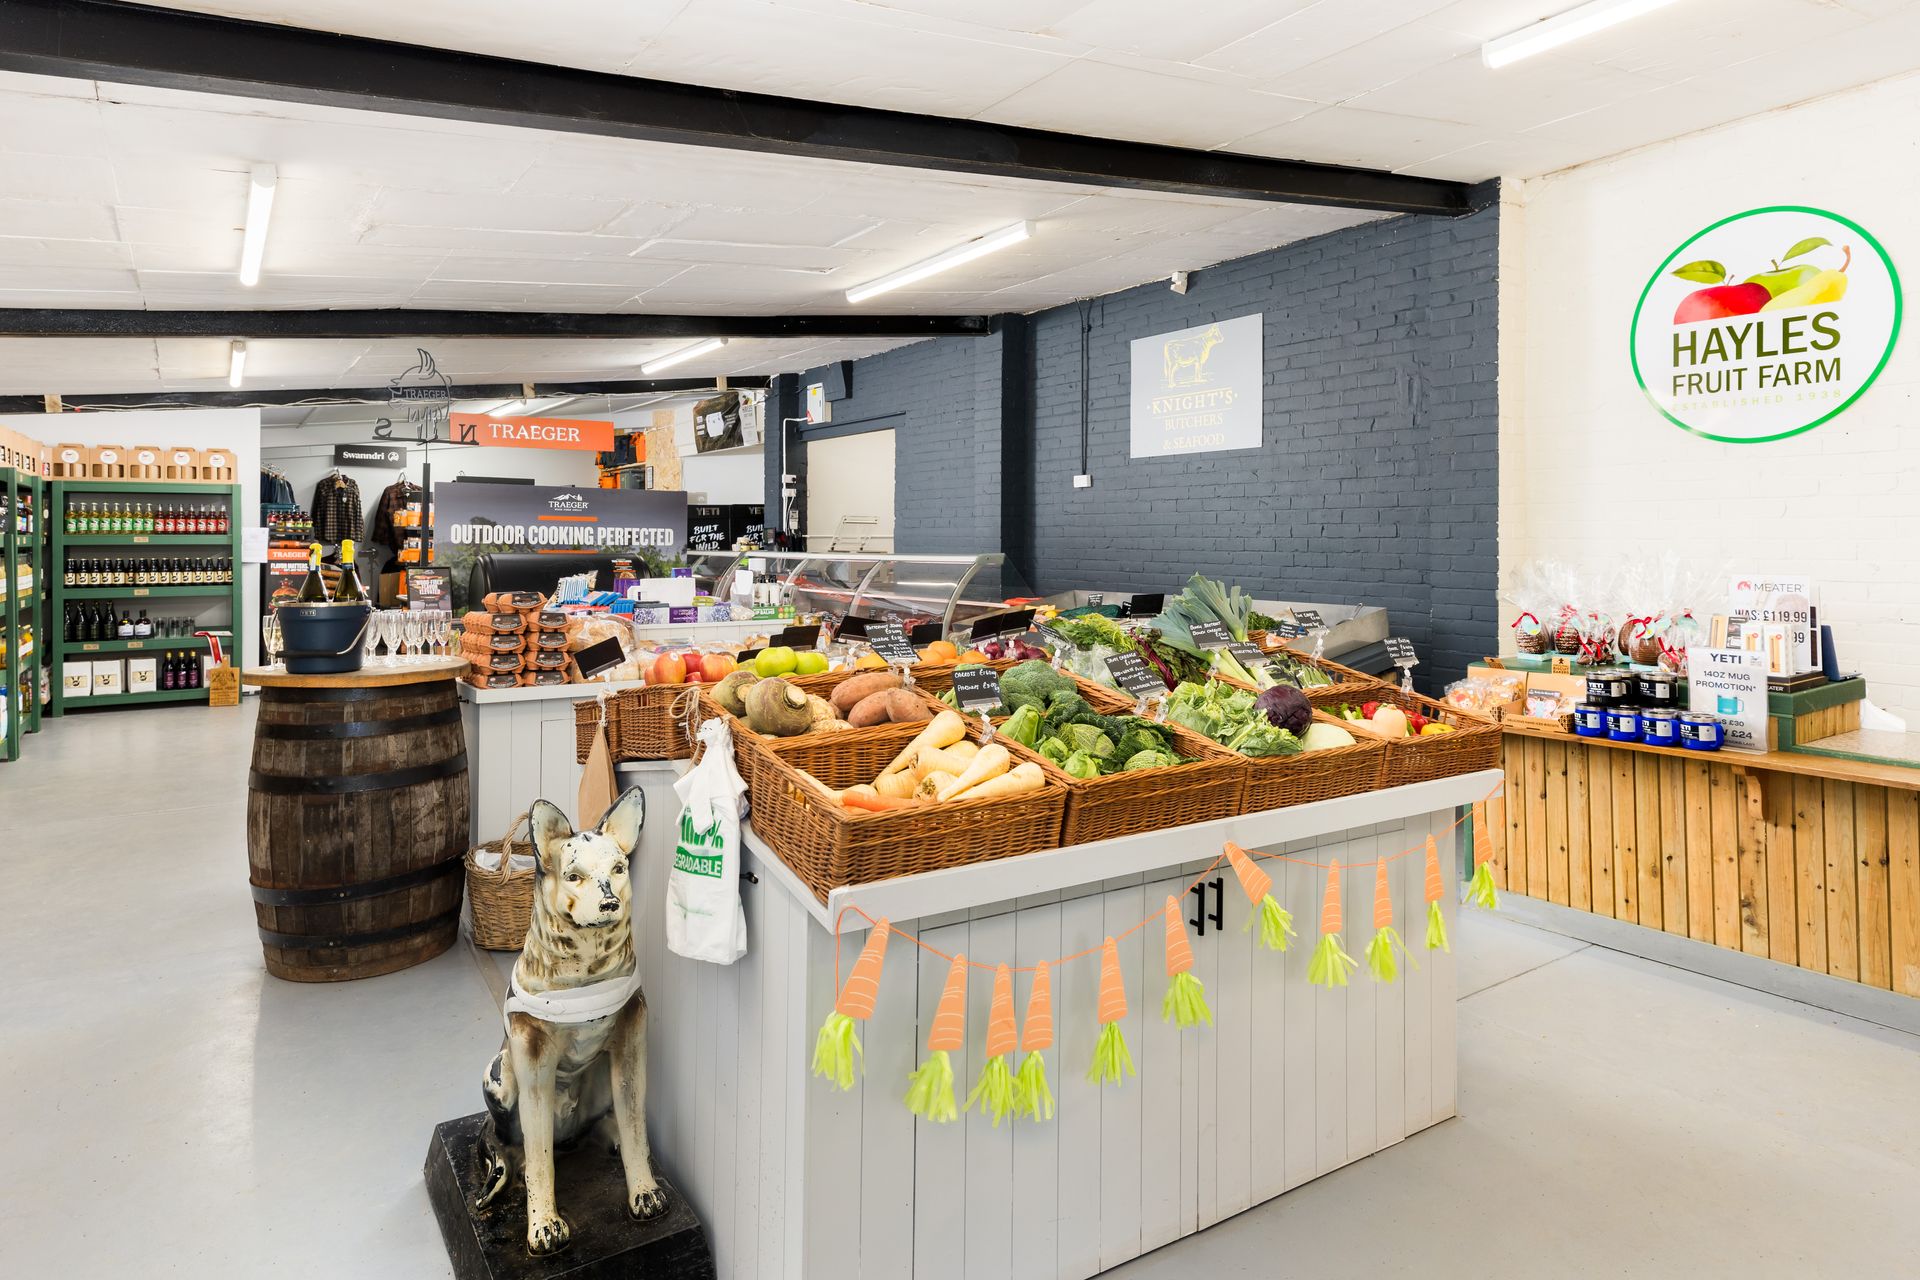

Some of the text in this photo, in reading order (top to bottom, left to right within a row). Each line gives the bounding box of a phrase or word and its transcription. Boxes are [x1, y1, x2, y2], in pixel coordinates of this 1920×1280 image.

[1673, 311, 1841, 367] HAYLES
[1673, 357, 1841, 396] FRUIT FARM
[403, 389, 447, 399] TRAEGER
[1152, 390, 1233, 415] KNIGHT'S
[1672, 389, 1842, 412] ESTABLISHED 1938
[1165, 413, 1224, 432] BUTCHERS
[488, 423, 581, 442] TRAEGER
[1163, 433, 1225, 450] & SEAFOOD
[342, 451, 385, 460] Swanndri
[696, 507, 720, 516] YETI
[693, 524, 719, 535] BUILT
[746, 524, 763, 533] BUIL
[451, 524, 674, 546] OUTDOOR COOKING PERFECTED
[689, 532, 725, 543] FOR THE
[695, 542, 720, 551] WILD.
[1754, 583, 1802, 593] MEATER
[1763, 610, 1807, 623] £119.99
[1710, 653, 1742, 664] YETI
[1728, 672, 1751, 681] MUG
[1731, 729, 1753, 740] £24
